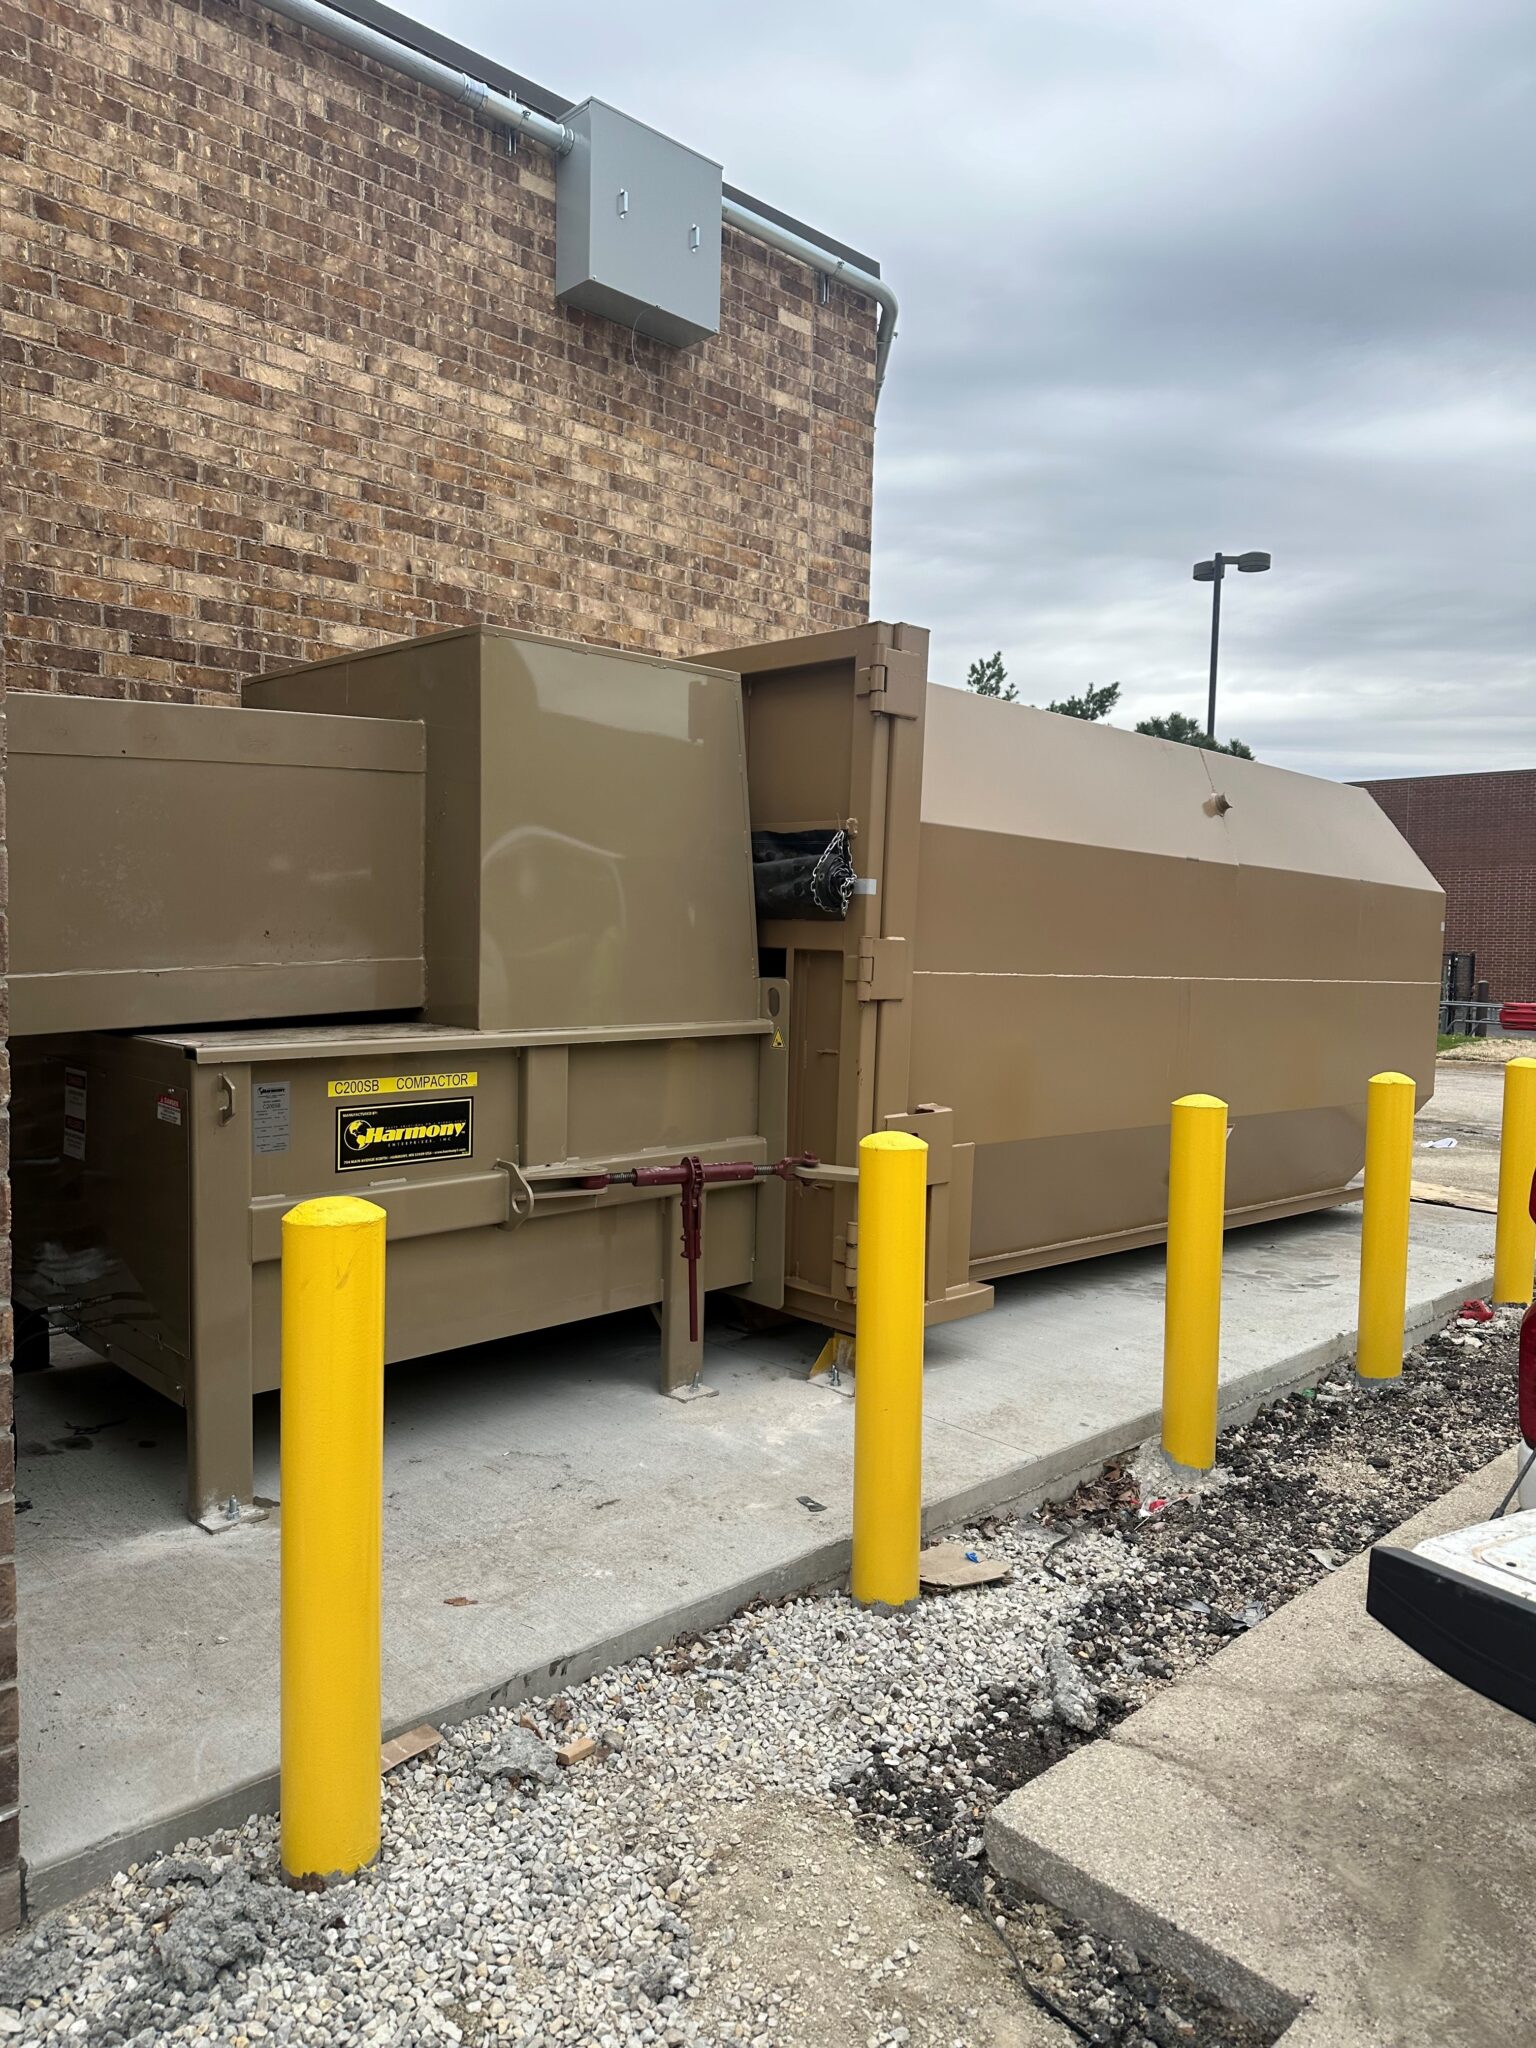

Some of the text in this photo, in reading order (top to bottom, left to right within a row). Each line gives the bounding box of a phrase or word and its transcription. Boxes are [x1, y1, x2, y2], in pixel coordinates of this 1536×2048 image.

[334, 1073, 468, 1095] C200SB COMPACTOR
[364, 1121, 466, 1144] Harmony
